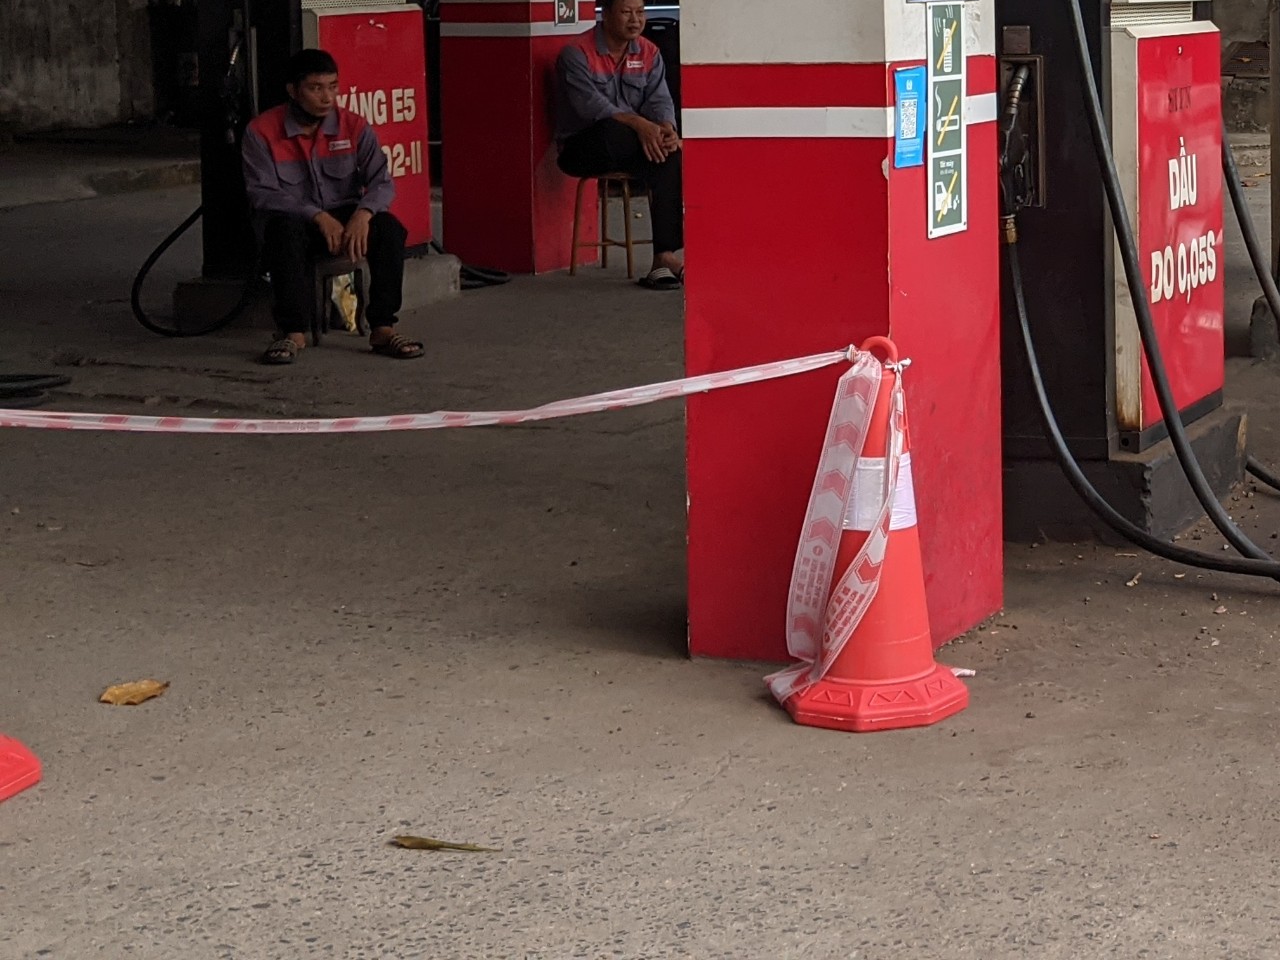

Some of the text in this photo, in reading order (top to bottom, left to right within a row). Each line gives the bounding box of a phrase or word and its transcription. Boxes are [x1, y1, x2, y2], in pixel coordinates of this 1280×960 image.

[391, 88, 416, 122] E5
[1168, 136, 1197, 210] DẦU
[1151, 230, 1217, 304] DO 0,05S
